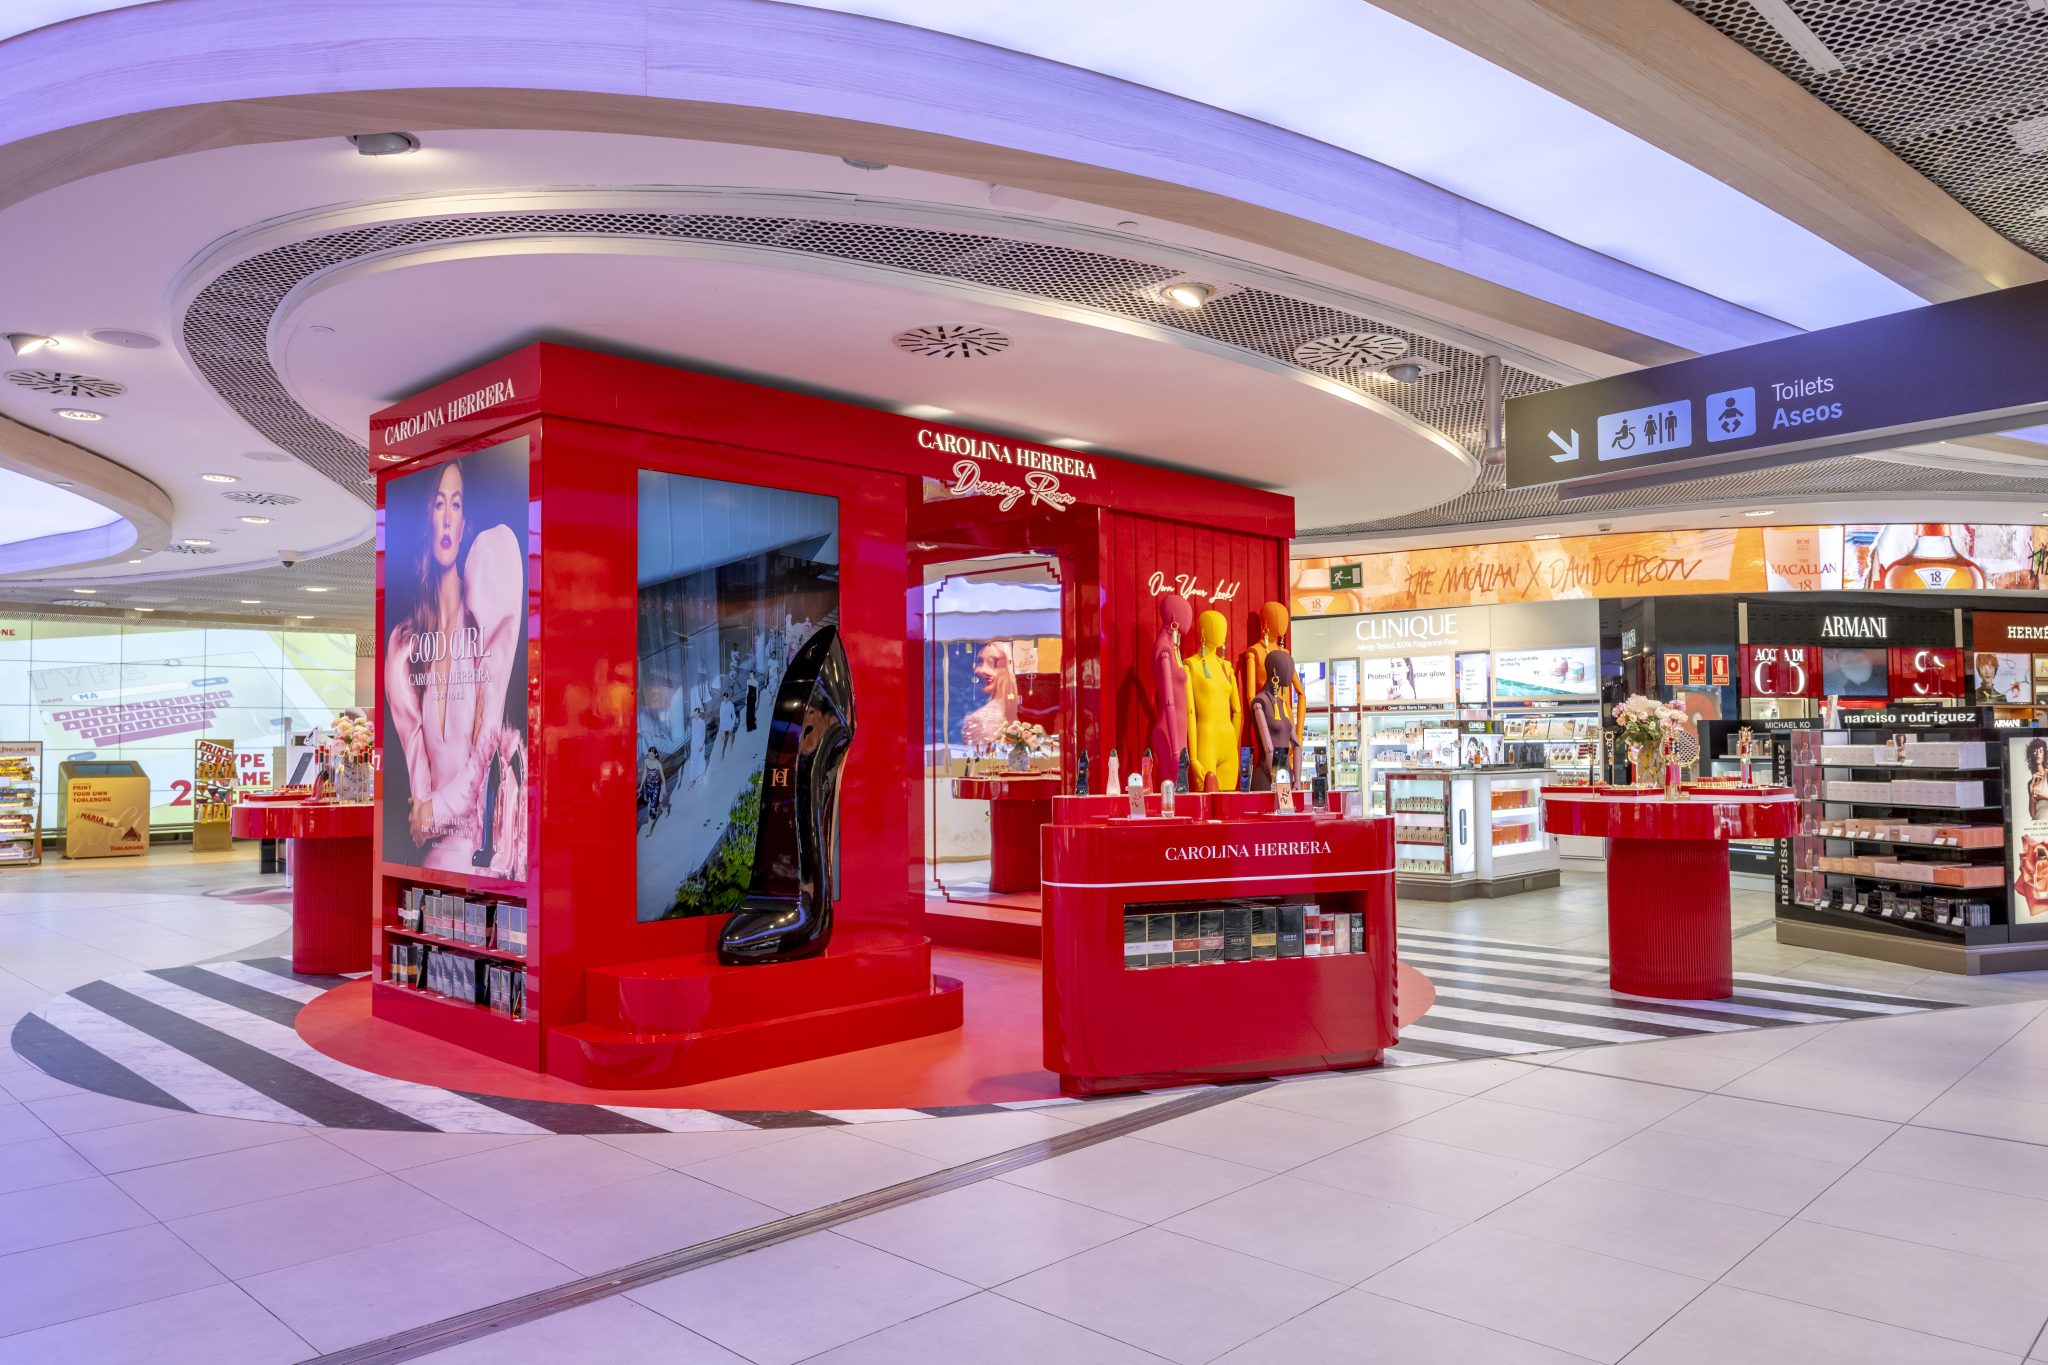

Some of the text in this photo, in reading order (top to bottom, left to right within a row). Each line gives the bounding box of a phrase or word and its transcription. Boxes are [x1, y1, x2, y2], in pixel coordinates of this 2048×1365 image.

[1771, 375, 1834, 402] Toilets
[384, 377, 515, 446] CAROLINA HERRERA
[1772, 400, 1843, 430] Aseos
[918, 429, 1097, 480] CAROLINA HERRERA
[950, 460, 1076, 512] Dressing Room
[1405, 569, 1438, 600] THE
[1521, 560, 1542, 598] X
[1550, 555, 1600, 593] DAVID
[1606, 553, 1702, 587] CARSON
[1771, 563, 1837, 575] MACALLAN
[1929, 570, 1942, 583] 18
[1798, 579, 1812, 591] 18
[1312, 598, 1322, 609] 18
[1355, 613, 1458, 641] CLINIQUE
[1821, 615, 1887, 638] ARMANI
[409, 626, 492, 664] GOOD GIRL
[1792, 649, 1804, 662] DI
[408, 668, 491, 687] CAROLINA HERRERA
[79, 692, 99, 700] MA
[1765, 721, 1797, 729] MICHAEL
[1844, 711, 1976, 726] narciso rodriguez
[169, 779, 192, 806] 2
[1165, 841, 1332, 861] CAROLINA HERRERA
[1779, 838, 1789, 906] narciso
